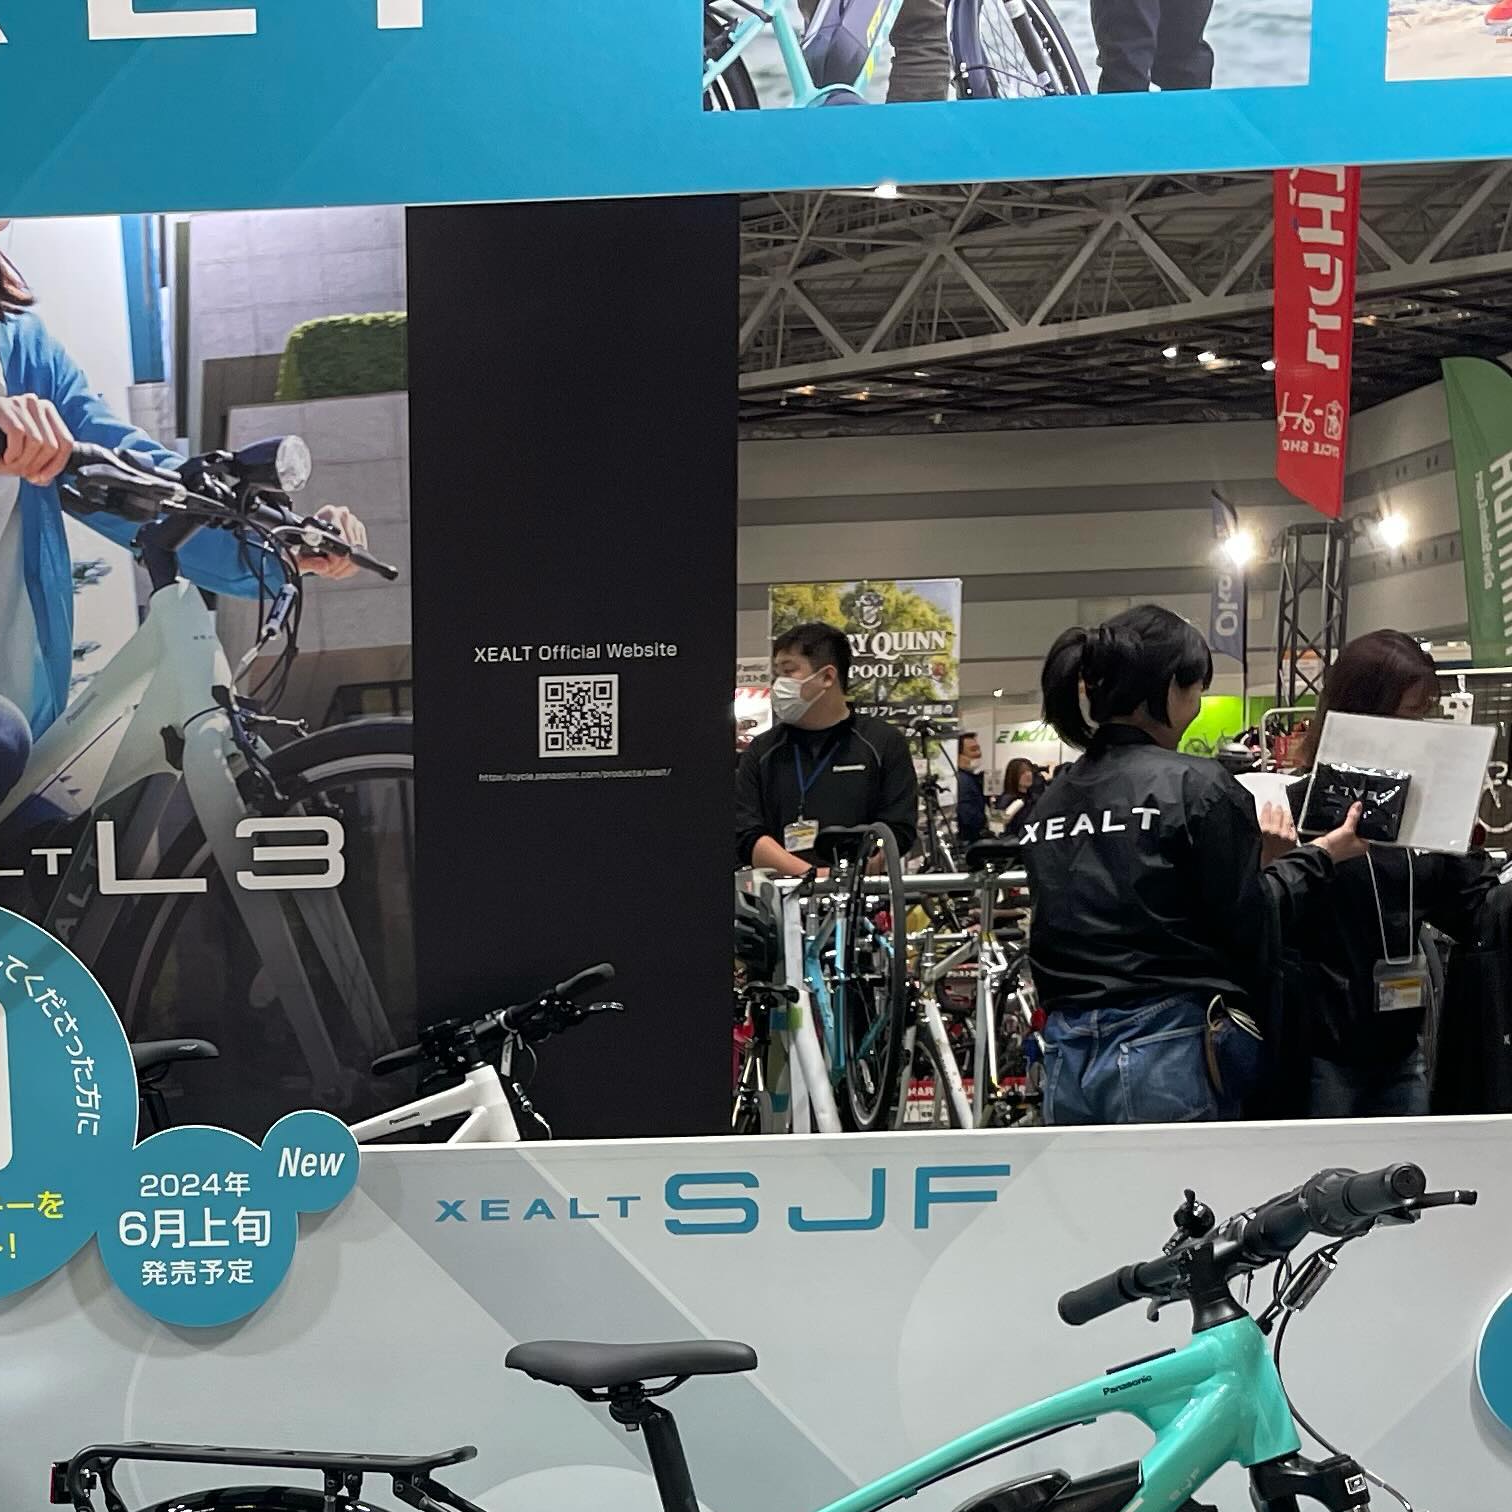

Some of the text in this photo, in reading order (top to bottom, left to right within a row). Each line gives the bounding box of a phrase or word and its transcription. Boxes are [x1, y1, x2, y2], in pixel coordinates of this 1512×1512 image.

[474, 641, 678, 663] XEALT Official Website
[1019, 807, 1161, 845] XEALT
[96, 816, 346, 895] L3
[278, 1147, 346, 1178] New
[140, 1171, 251, 1197] 2024年
[434, 1164, 1011, 1235] XEALT SJF
[118, 1206, 272, 1249] 6月上旬
[141, 1258, 254, 1286] 発売予定
[1102, 1375, 1153, 1396] Panasonic
